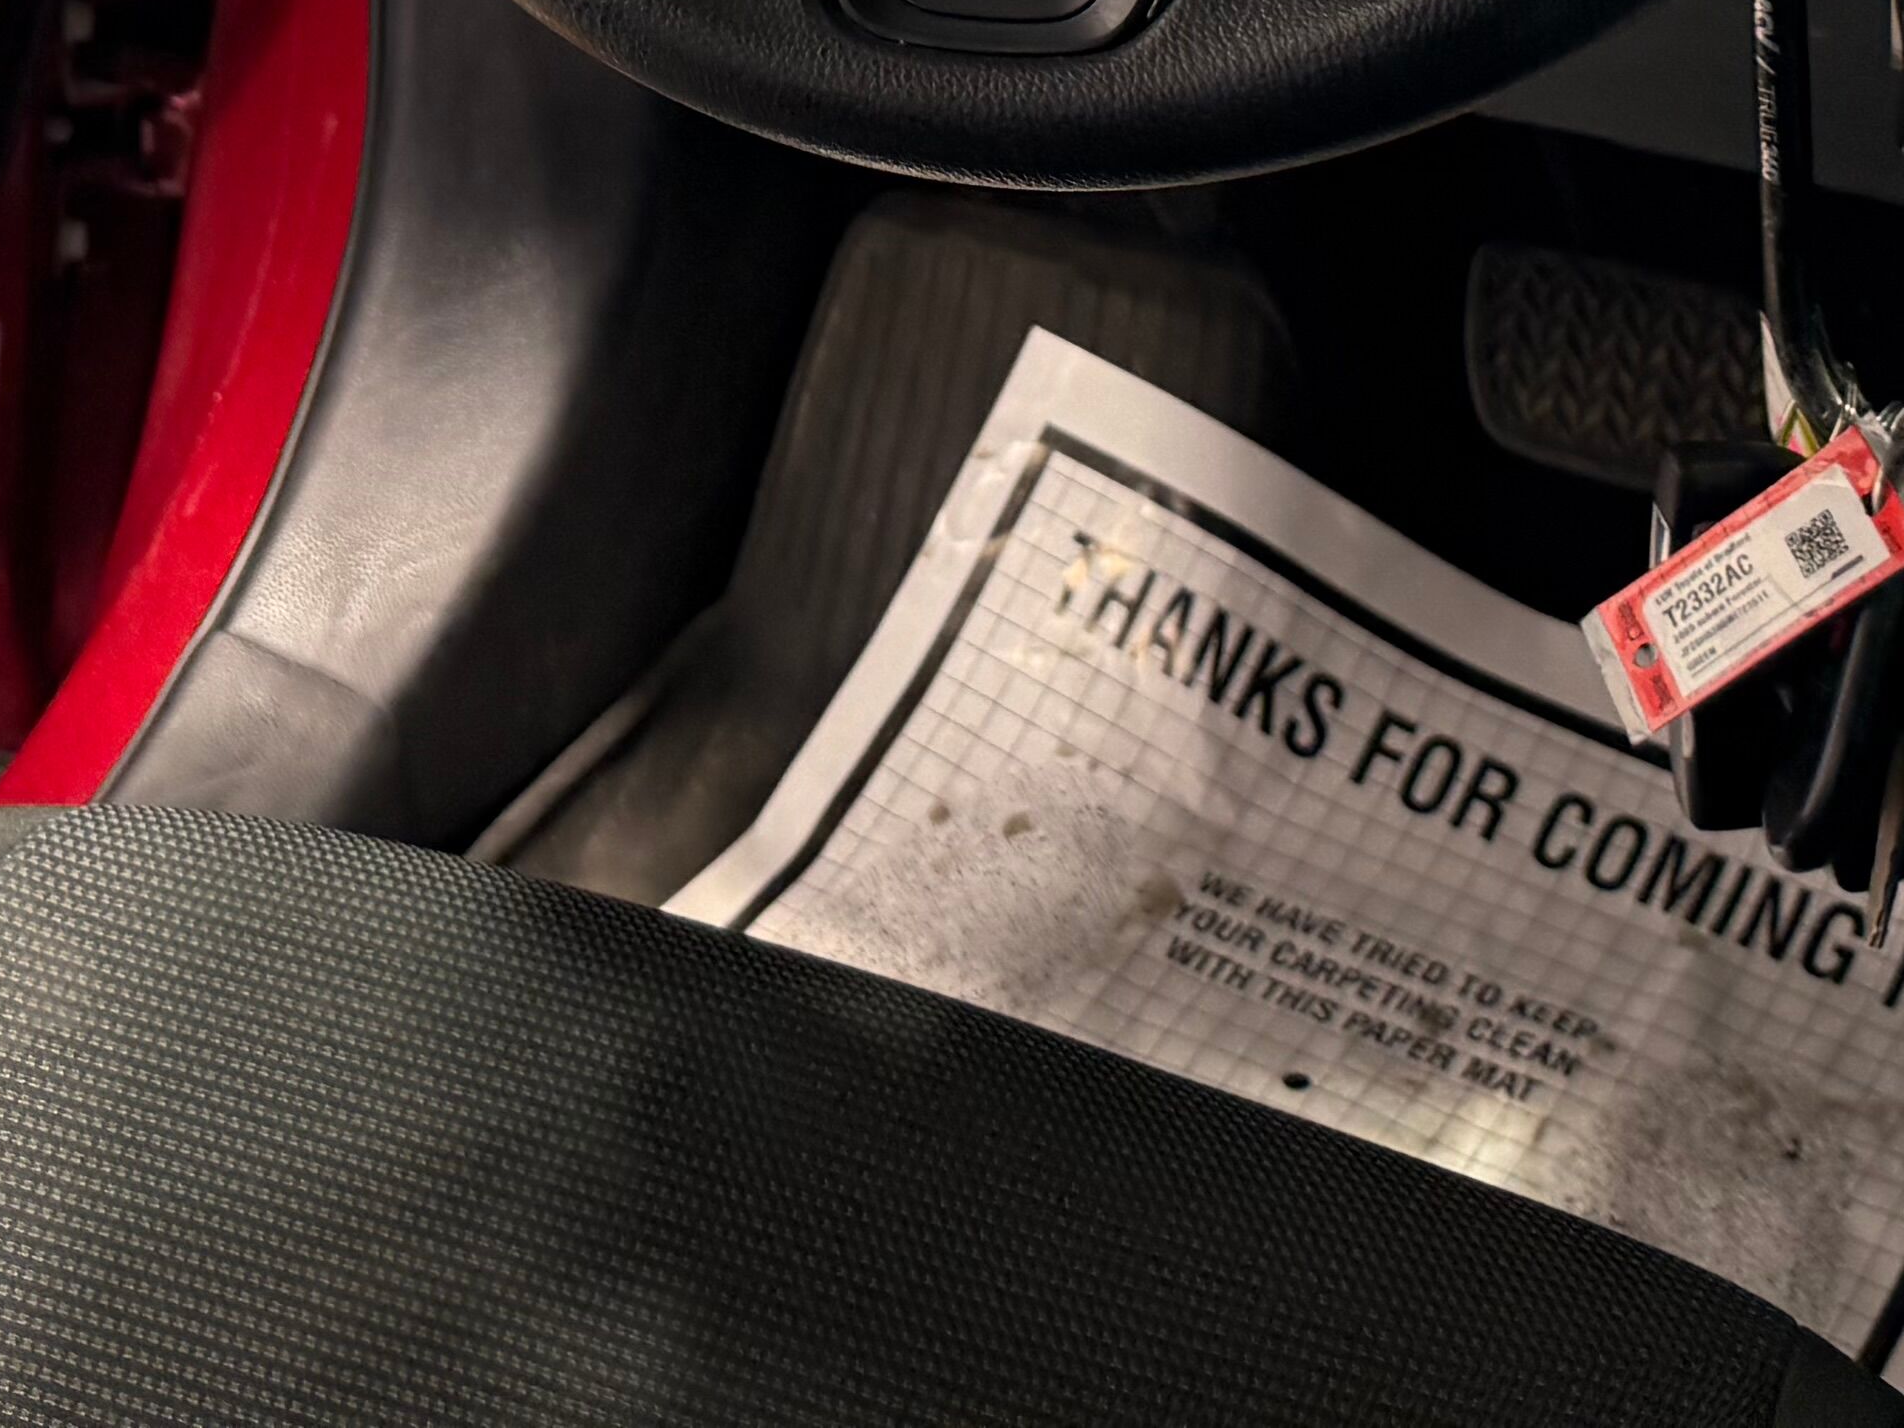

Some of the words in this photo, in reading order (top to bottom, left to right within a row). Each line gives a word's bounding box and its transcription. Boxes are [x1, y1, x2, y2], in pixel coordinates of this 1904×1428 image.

[1661, 552, 1754, 629] T2332AC
[1052, 529, 1346, 762] THANKS
[1349, 708, 1523, 845] FOR
[1533, 790, 1879, 988] COMING
[1165, 934, 1256, 990] WITH
[1258, 974, 1339, 1025] THIS
[1340, 1009, 1458, 1072] PAPER
[1459, 1058, 1545, 1104] MAT
[1174, 900, 1266, 953] YOUR
[1269, 939, 1462, 1031] CARPETING
[1465, 1015, 1583, 1079] CLEAN
[1197, 869, 1254, 909] WE
[1254, 894, 1349, 945] HAVE
[1348, 930, 1451, 986] TRIED
[1456, 971, 1503, 1008] TO
[1507, 993, 1602, 1040] KEEP
